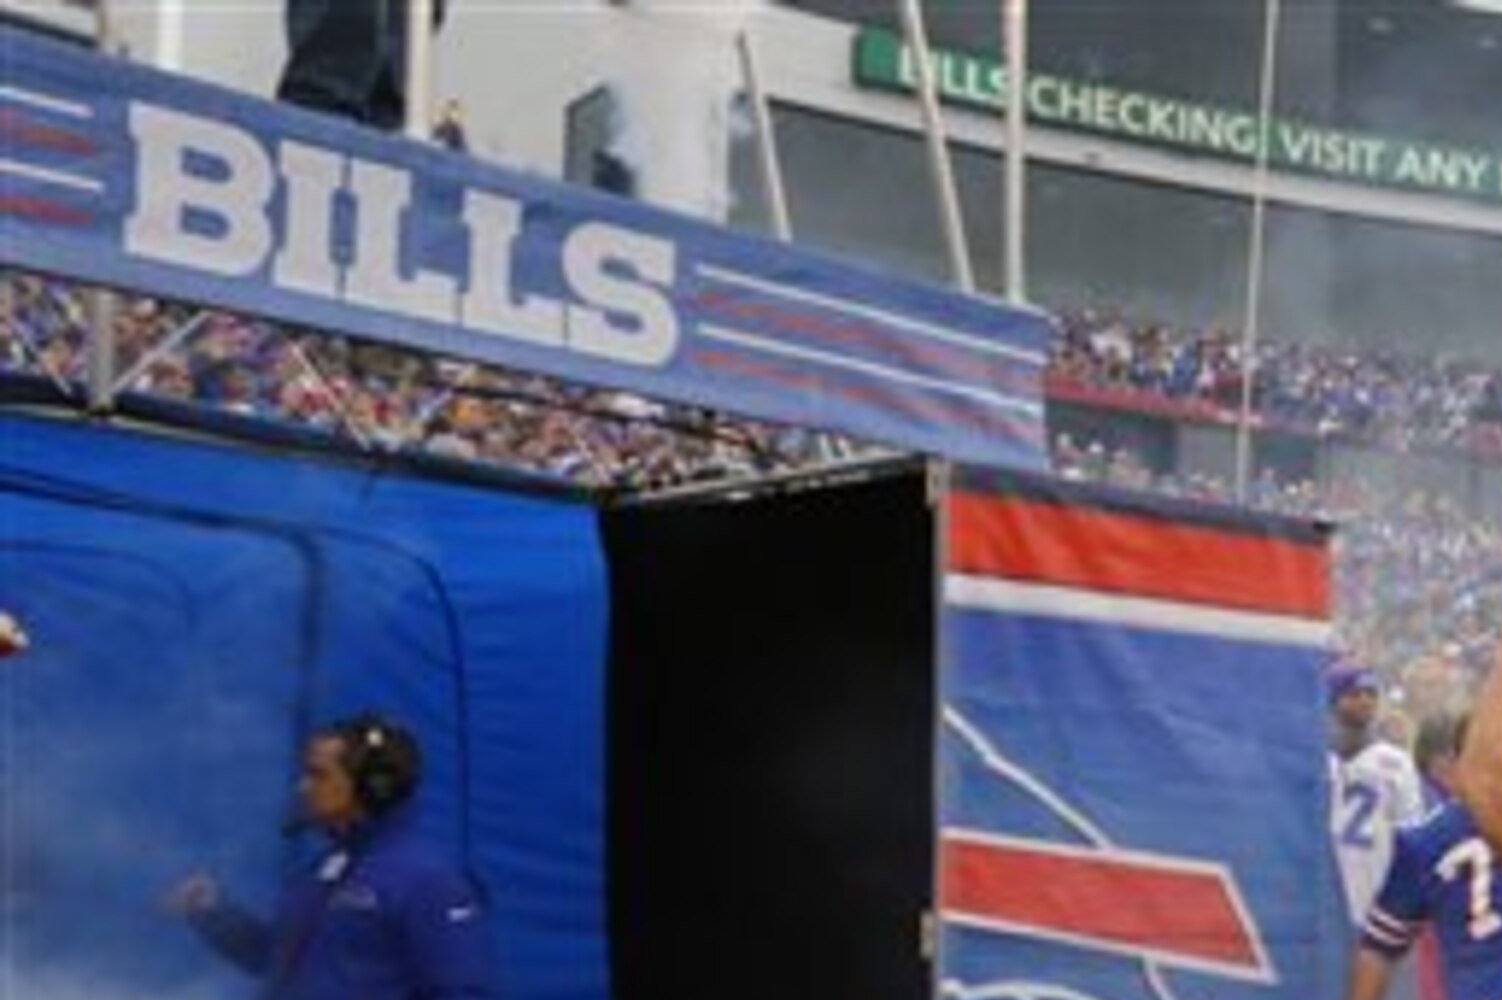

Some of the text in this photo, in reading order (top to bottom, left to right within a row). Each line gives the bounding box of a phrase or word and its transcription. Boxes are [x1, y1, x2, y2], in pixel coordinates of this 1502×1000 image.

[124, 102, 680, 366] BILLS
[1279, 121, 1386, 174] VISIT
[1396, 143, 1490, 190] ANY
